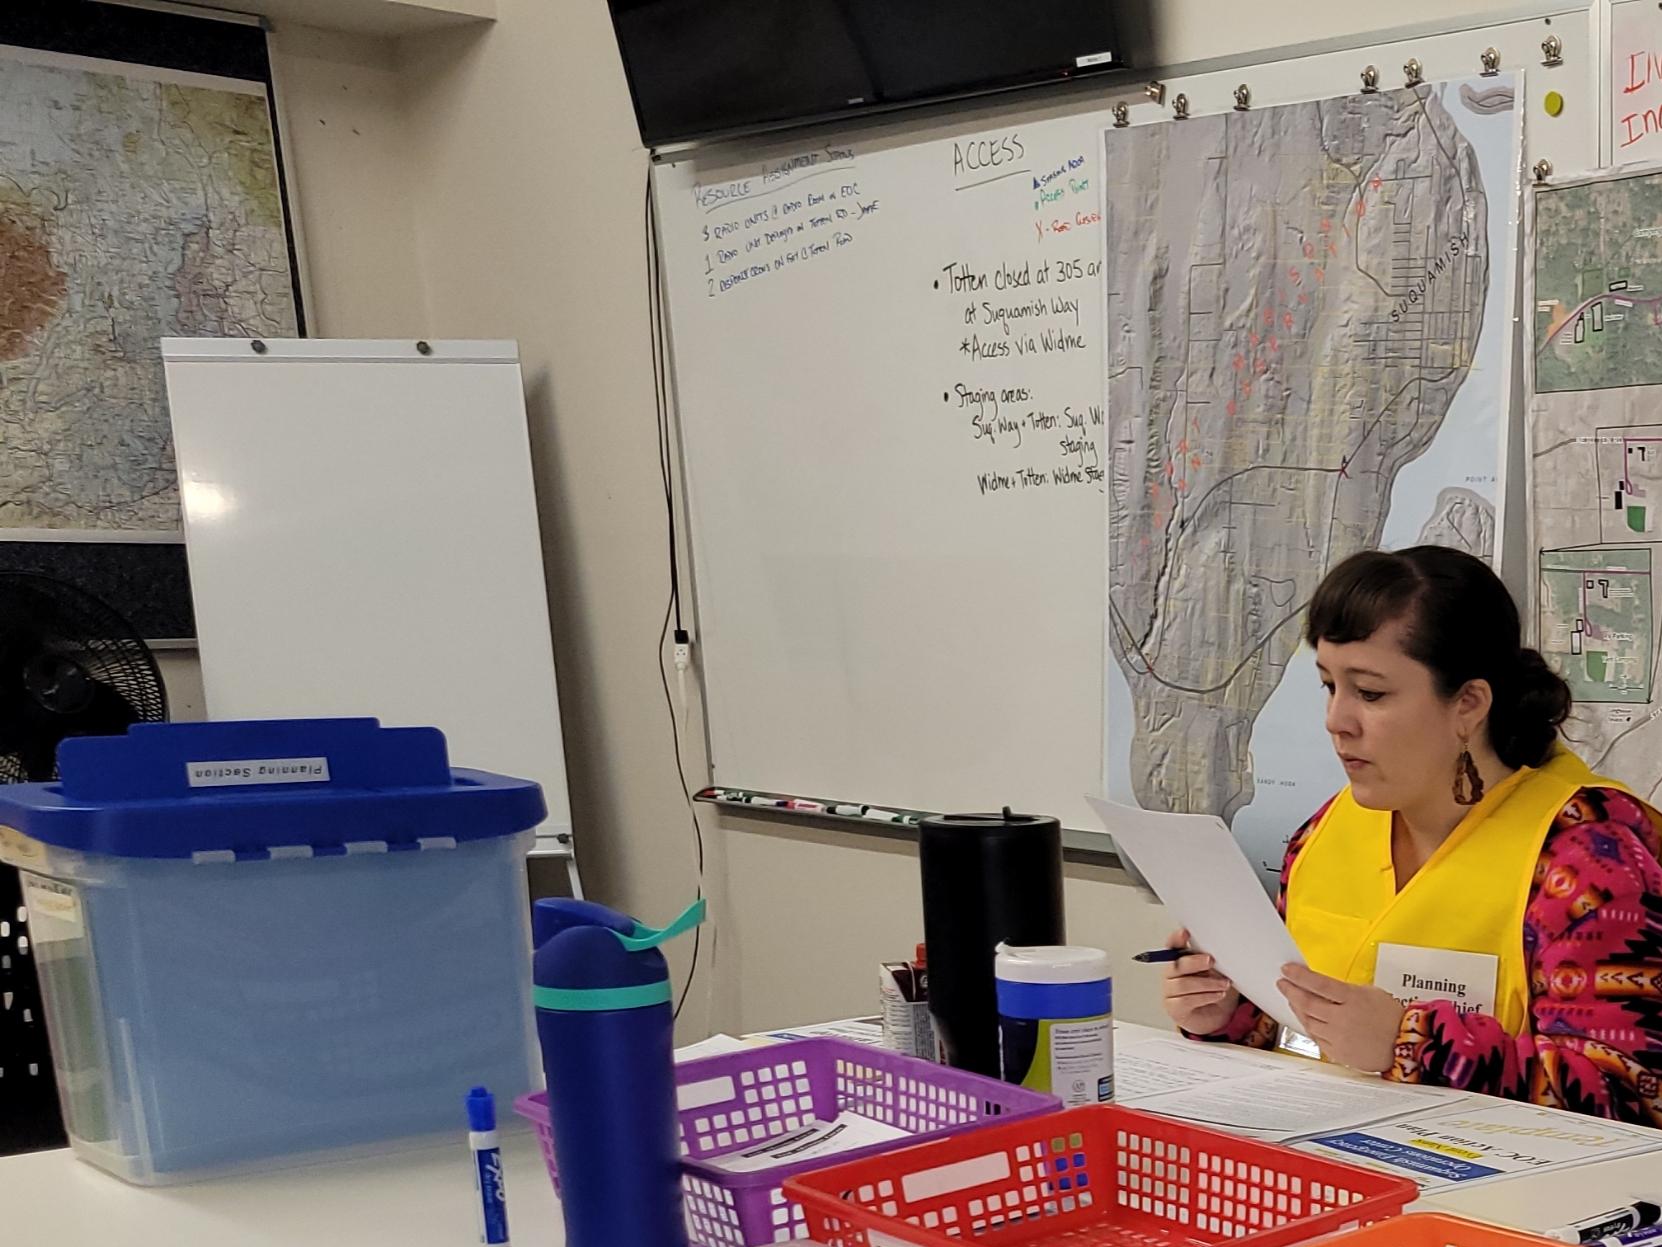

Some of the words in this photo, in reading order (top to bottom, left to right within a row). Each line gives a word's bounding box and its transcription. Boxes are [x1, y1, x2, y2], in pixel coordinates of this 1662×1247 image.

[953, 133, 1025, 176] ACCESS
[943, 262, 988, 294] Totten
[994, 260, 1031, 291] closed
[1037, 259, 1050, 284] at
[1056, 258, 1083, 283] 305
[1390, 231, 1470, 324] SUQUAMISH
[964, 302, 977, 325] at
[982, 297, 1047, 336] Suquamish
[1050, 296, 1080, 327] Way
[1015, 333, 1038, 356] via
[1040, 328, 1087, 352] Widme
[954, 382, 998, 422] Staging
[1000, 387, 1034, 404] areas:
[997, 416, 1023, 449] Way
[1059, 433, 1099, 468] staging
[193, 765, 252, 780] Section
[257, 763, 324, 779] Planning
[1402, 973, 1466, 998] Planning
[1452, 1001, 1483, 1015] hief
[1395, 1122, 1439, 1139] Plan
[1402, 1147, 1471, 1172] Operations
[1440, 1137, 1500, 1159] Action
[1496, 1149, 1552, 1167] EOC
[1392, 1155, 1465, 1183] Suquamish
